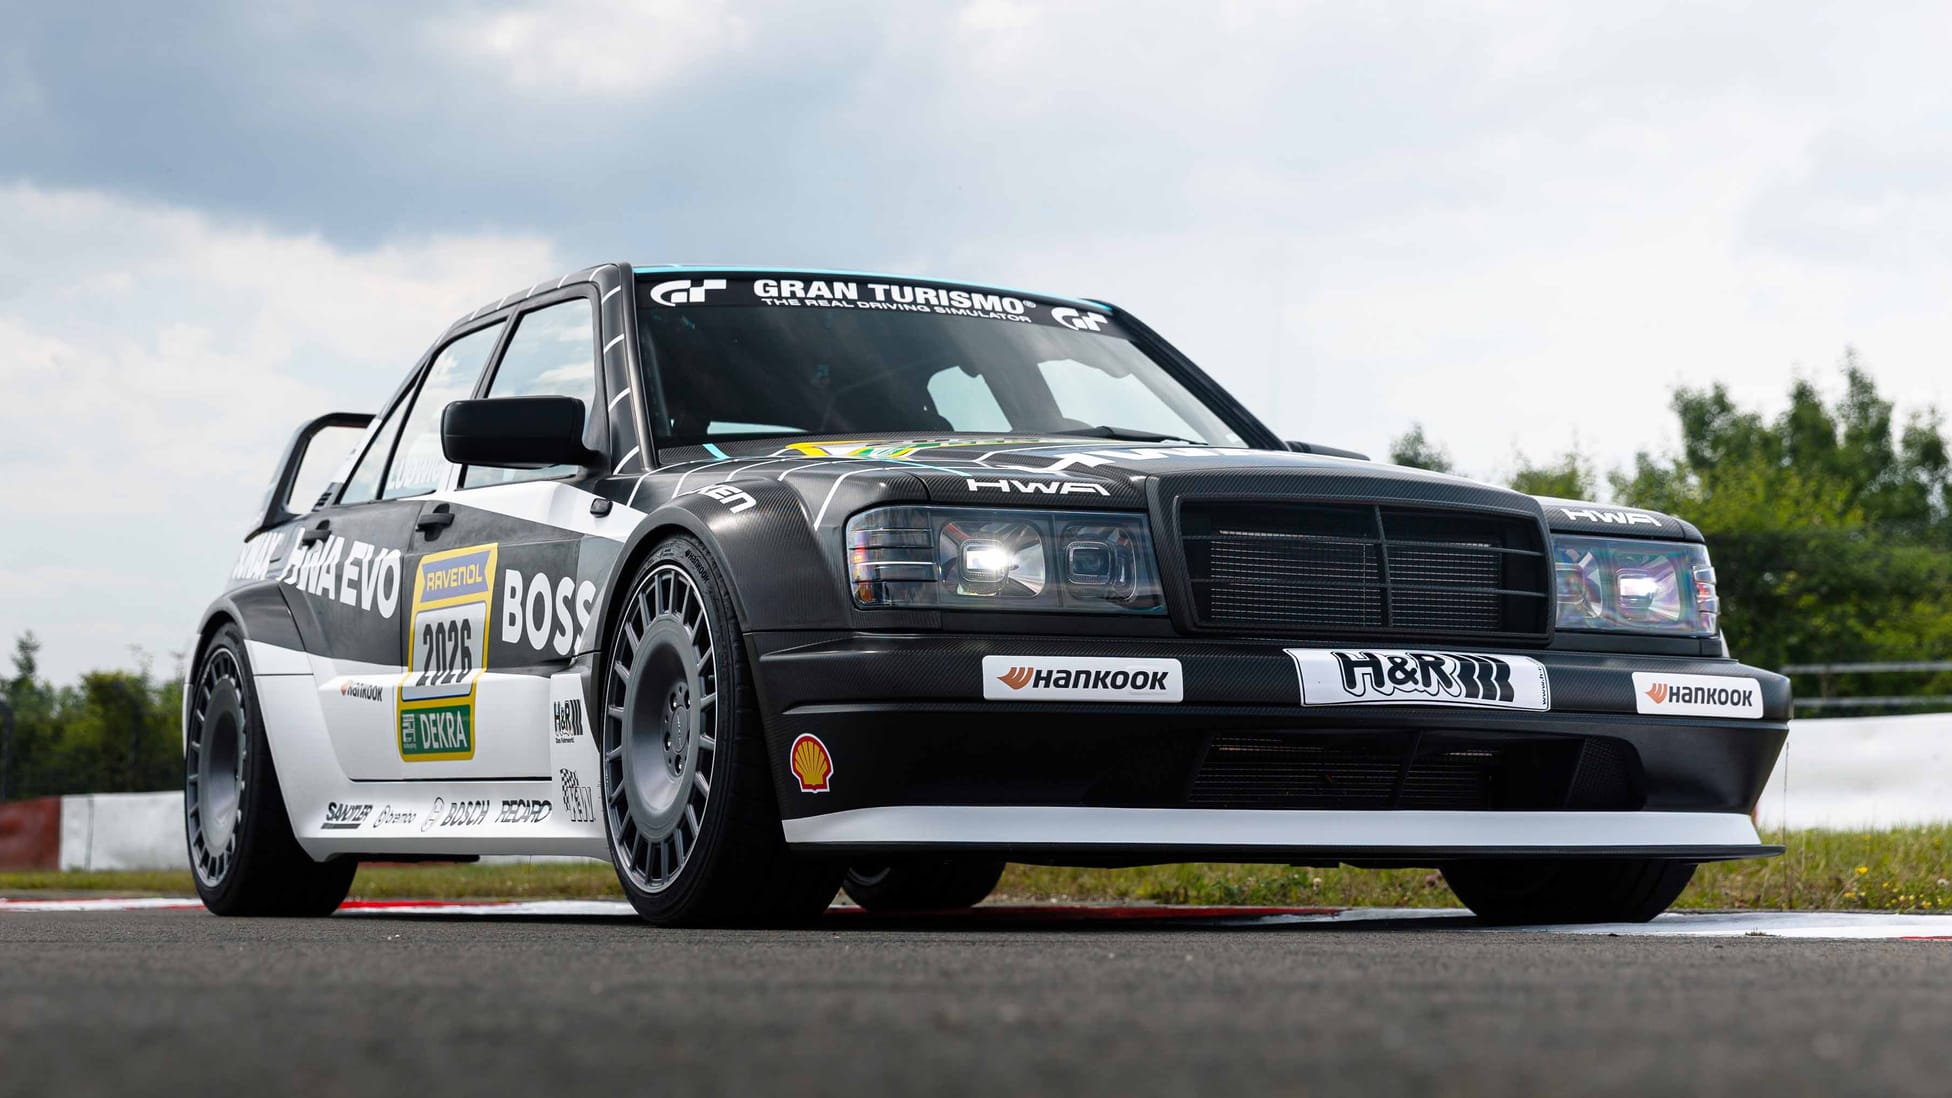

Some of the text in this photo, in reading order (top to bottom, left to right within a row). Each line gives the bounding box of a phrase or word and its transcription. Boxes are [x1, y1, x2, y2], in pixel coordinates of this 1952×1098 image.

[753, 279, 858, 300] GRAN
[761, 297, 1032, 323] THE REAL DRIVING SIMULATOR
[967, 478, 1110, 497] HWA
[1561, 508, 1662, 527] HWA
[339, 540, 402, 619] EVO
[426, 563, 483, 592] RAVENOL
[415, 618, 473, 687] 2026
[419, 710, 468, 750] DEKRA
[440, 800, 490, 826] BOSCH
[495, 799, 552, 823] RECARO
